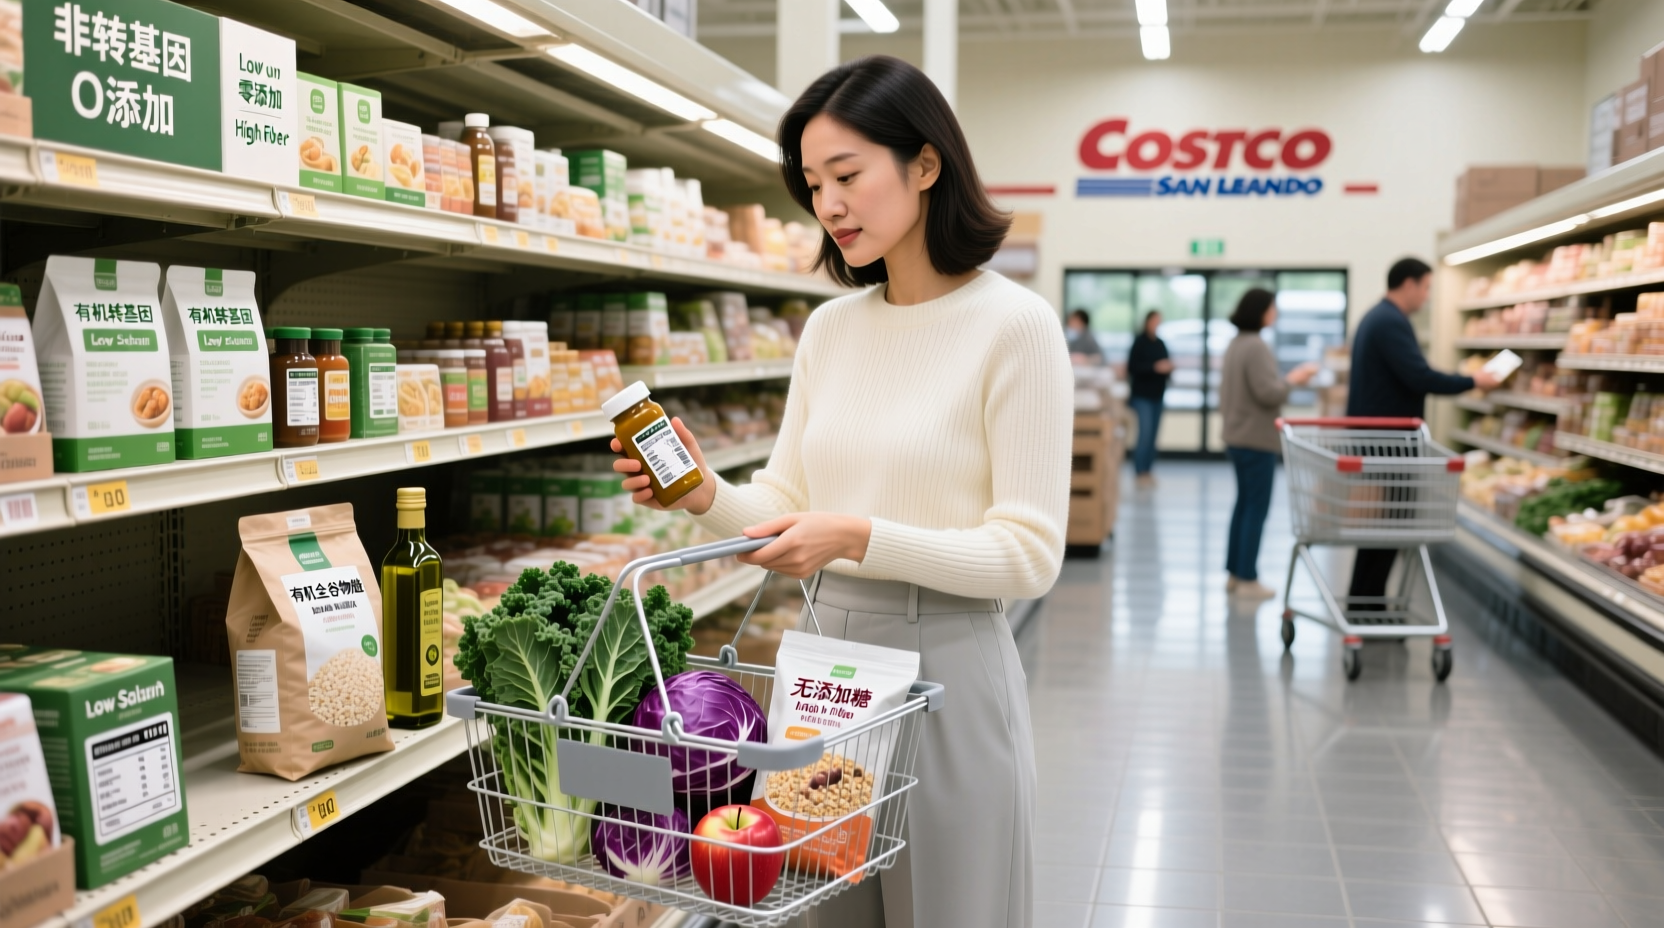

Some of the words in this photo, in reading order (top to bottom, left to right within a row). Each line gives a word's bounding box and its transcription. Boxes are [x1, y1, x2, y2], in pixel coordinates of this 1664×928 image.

[54, 2, 192, 82] 非转基因
[239, 52, 264, 75] Low
[238, 78, 282, 109] 零添加
[1156, 176, 1211, 195] SAN
[1216, 177, 1323, 195] LEANDO
[789, 677, 873, 708] 无添加糖
[84, 699, 116, 719] Low
